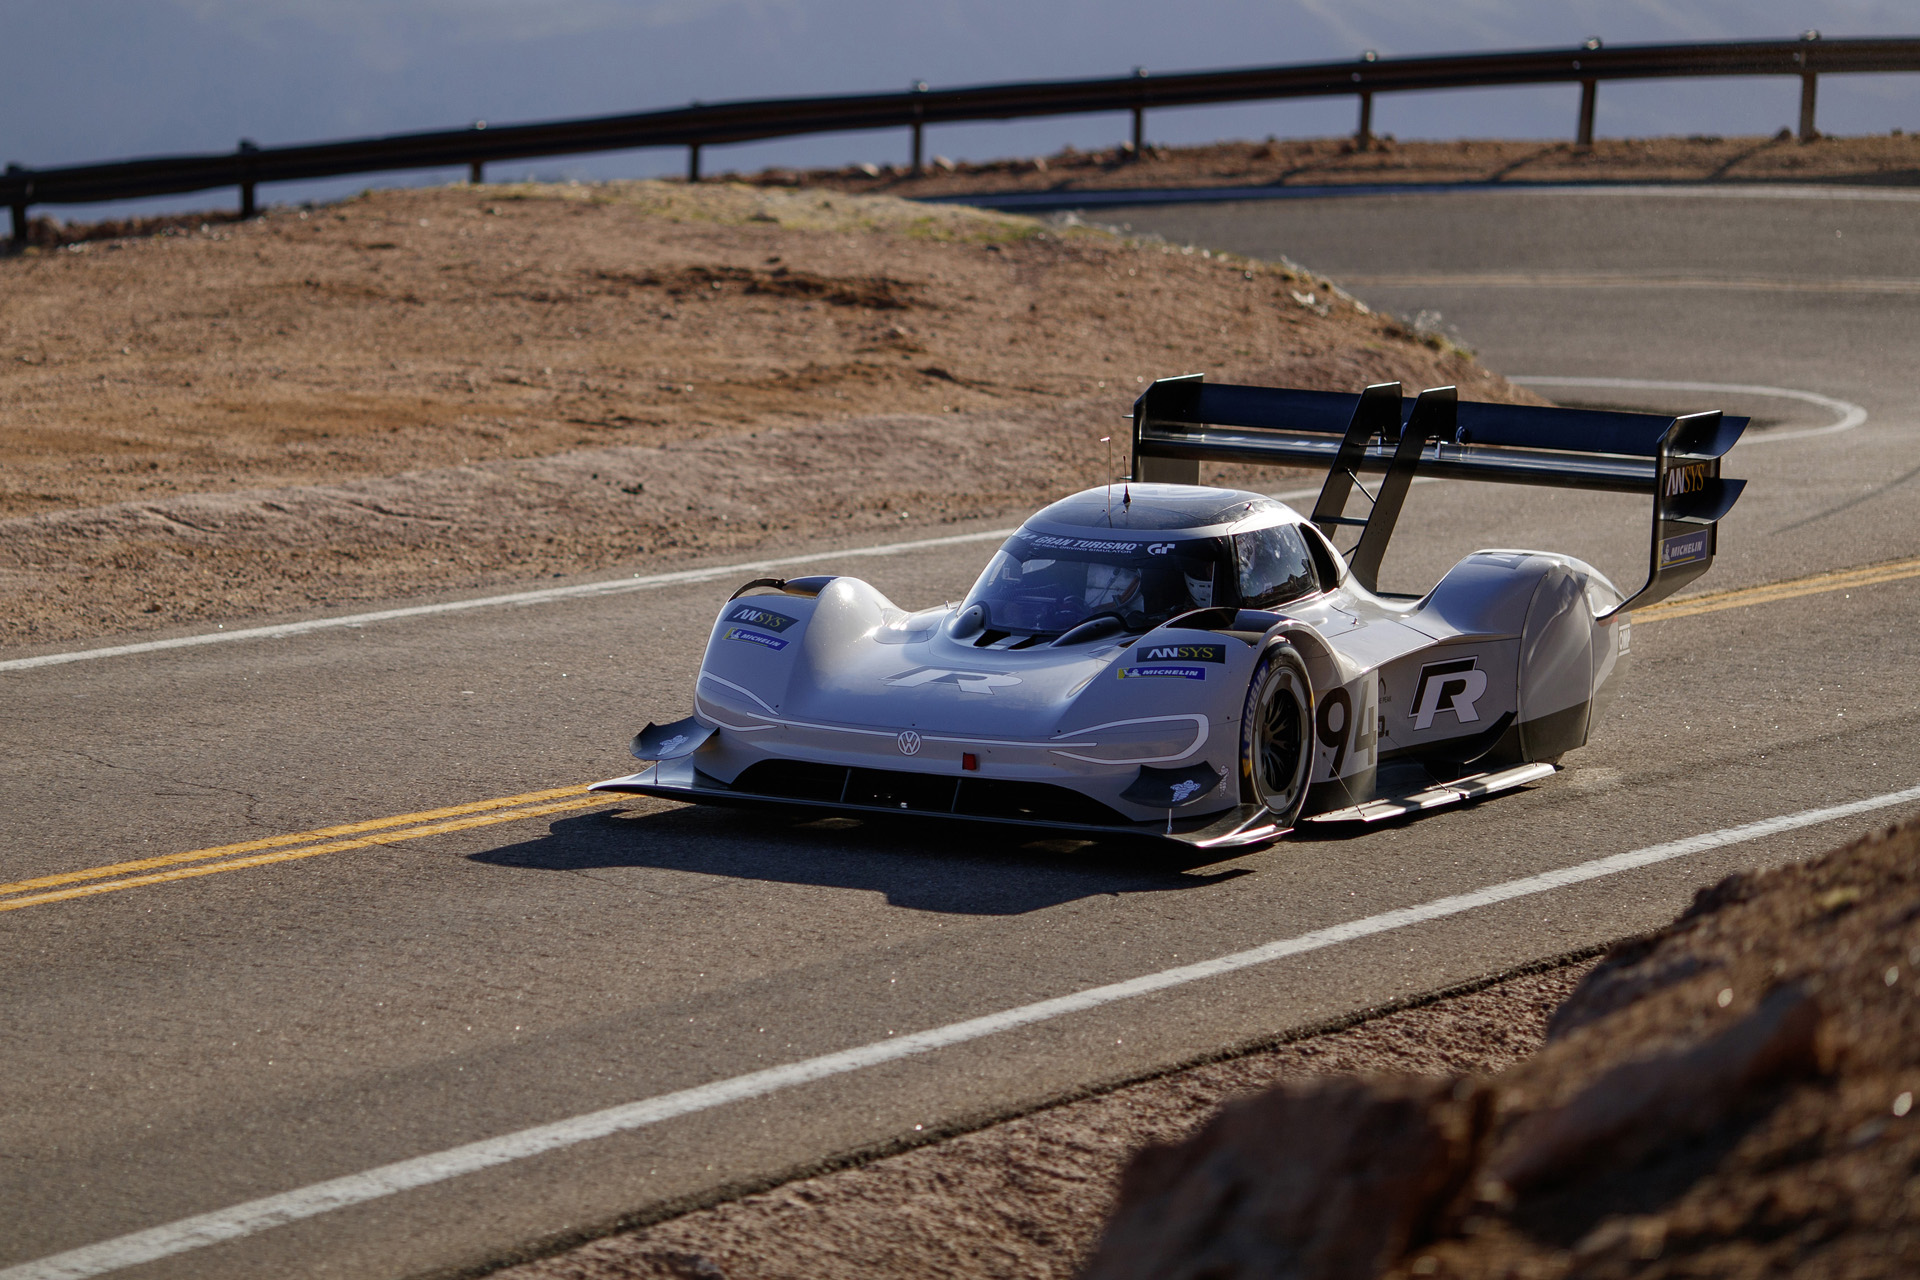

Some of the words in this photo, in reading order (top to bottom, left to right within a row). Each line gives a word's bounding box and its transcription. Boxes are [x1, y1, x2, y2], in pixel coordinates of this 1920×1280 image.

[1666, 463, 1705, 497] ANSYS
[1035, 536, 1072, 546] GRAN
[1073, 540, 1137, 551] TURISMO
[1671, 540, 1703, 558] MICHELIN
[733, 608, 786, 628] ANSYS
[741, 633, 781, 648] MICHELIN
[1147, 647, 1214, 659] ANSYS
[1142, 669, 1199, 677] MICHELIN
[1243, 665, 1267, 741] MICHELIN
[1411, 656, 1488, 732] R
[1316, 680, 1377, 779] 94
[898, 730, 921, 756] VW
